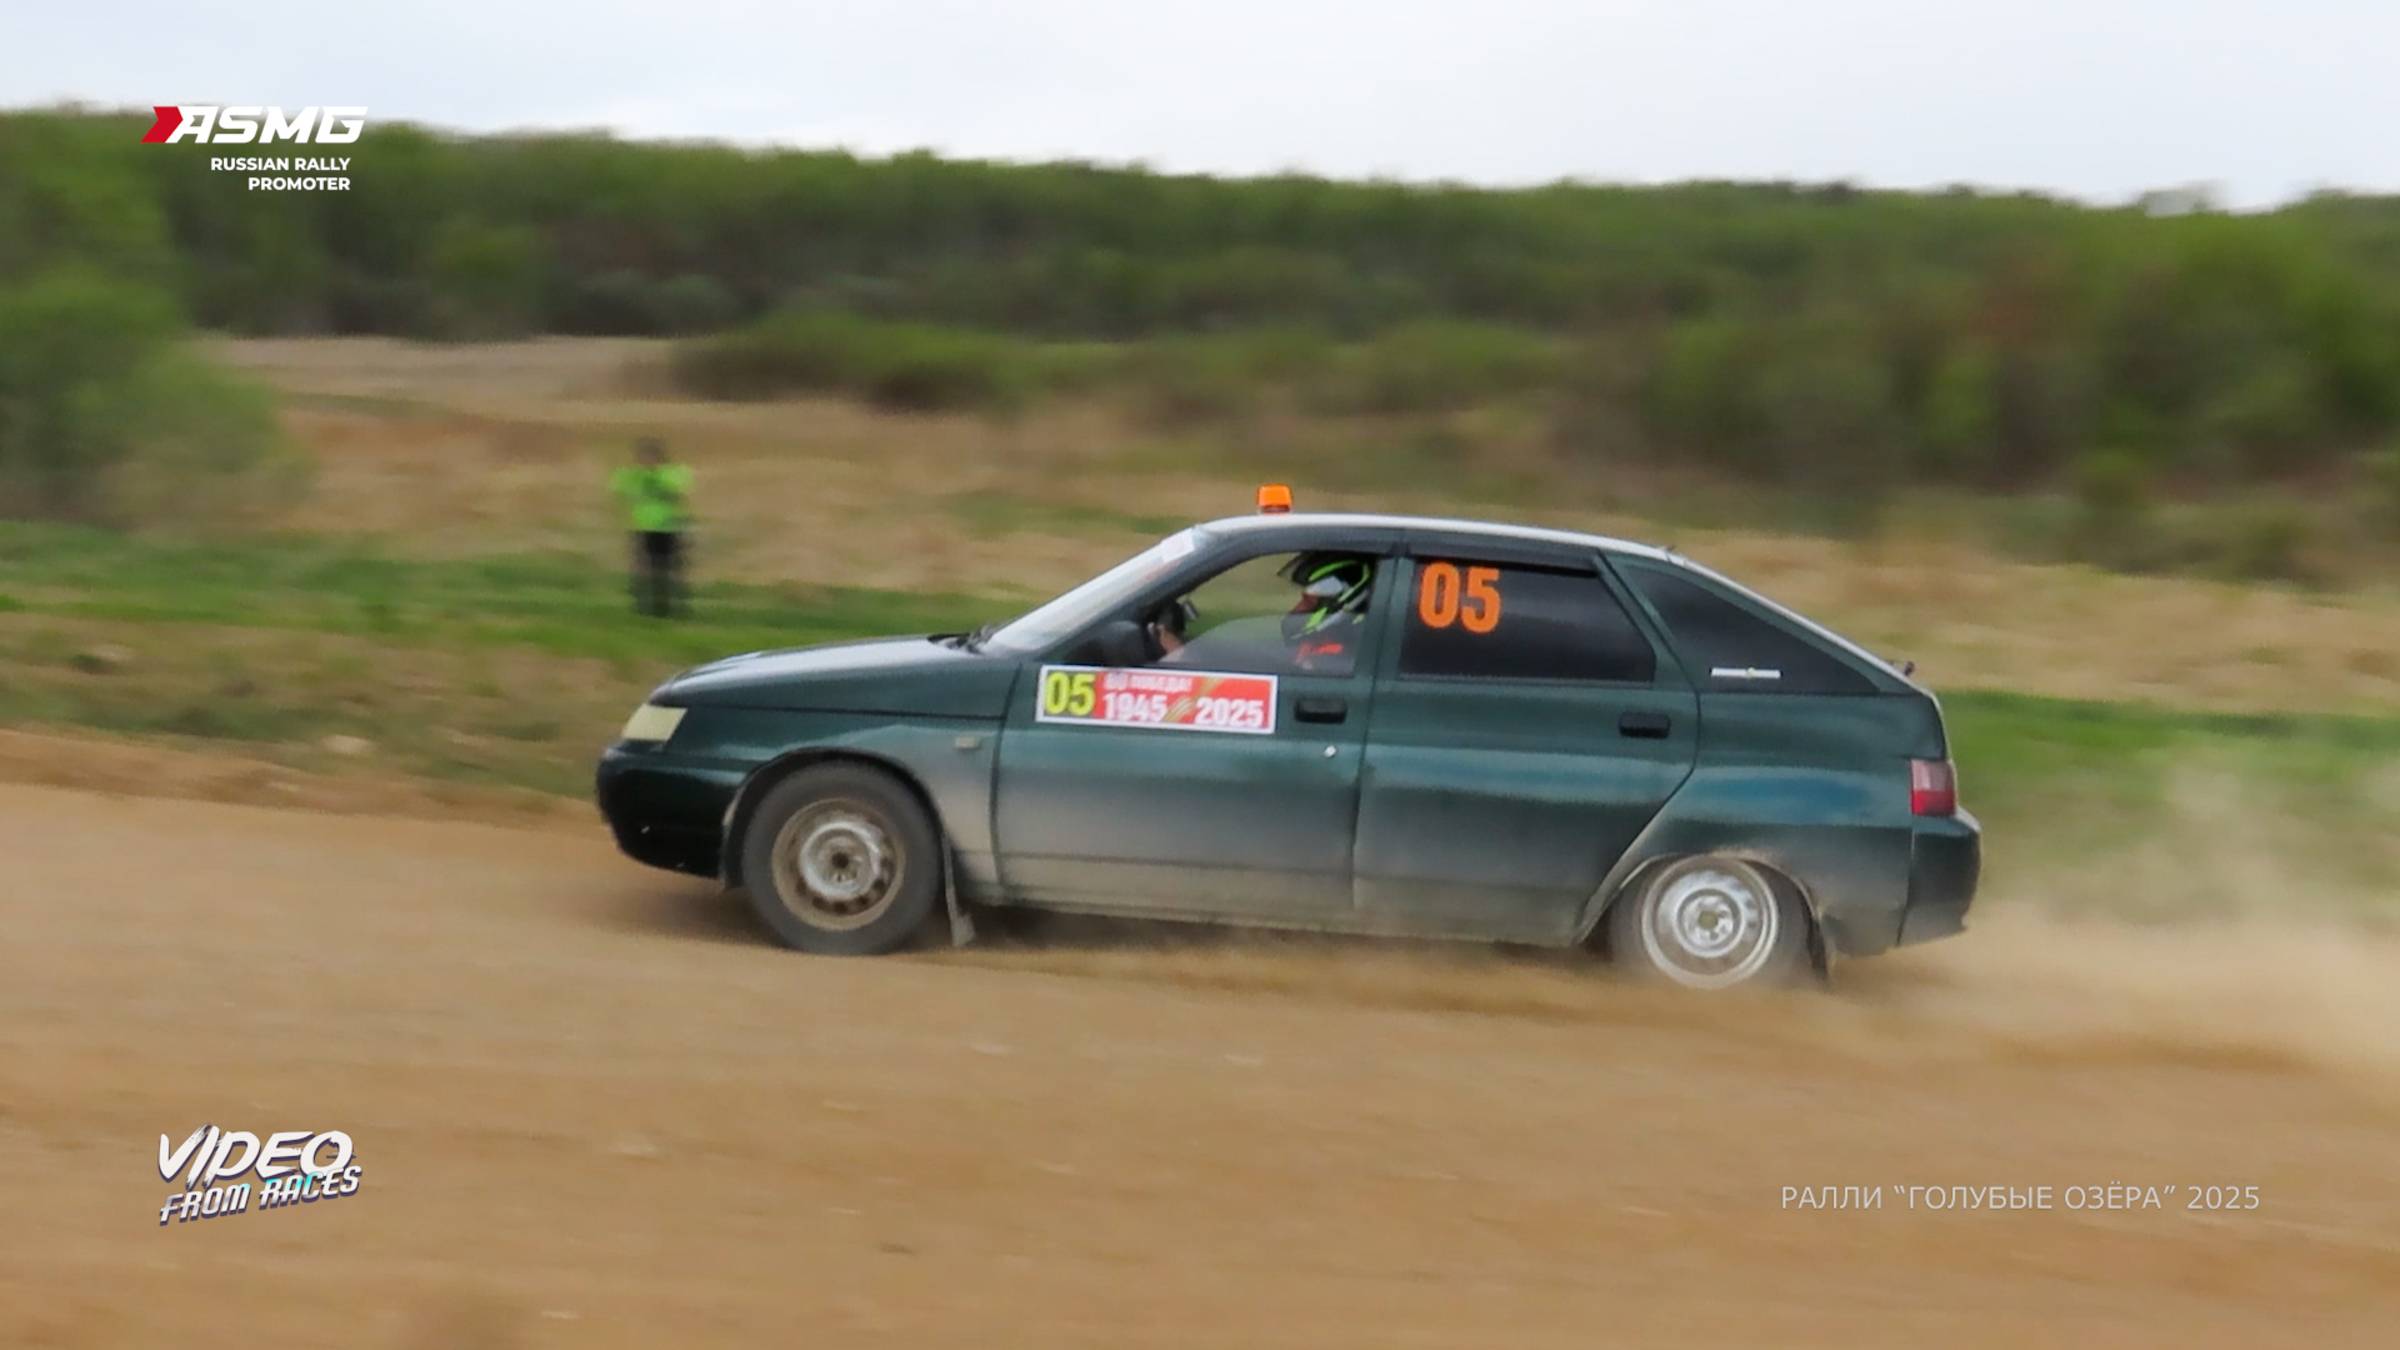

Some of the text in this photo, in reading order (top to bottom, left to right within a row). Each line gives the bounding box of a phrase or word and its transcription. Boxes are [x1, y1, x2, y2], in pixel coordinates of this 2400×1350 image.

[1418, 561, 1503, 634] 05
[1044, 671, 1097, 716] 05
[1103, 692, 1265, 729] 1945 2025
